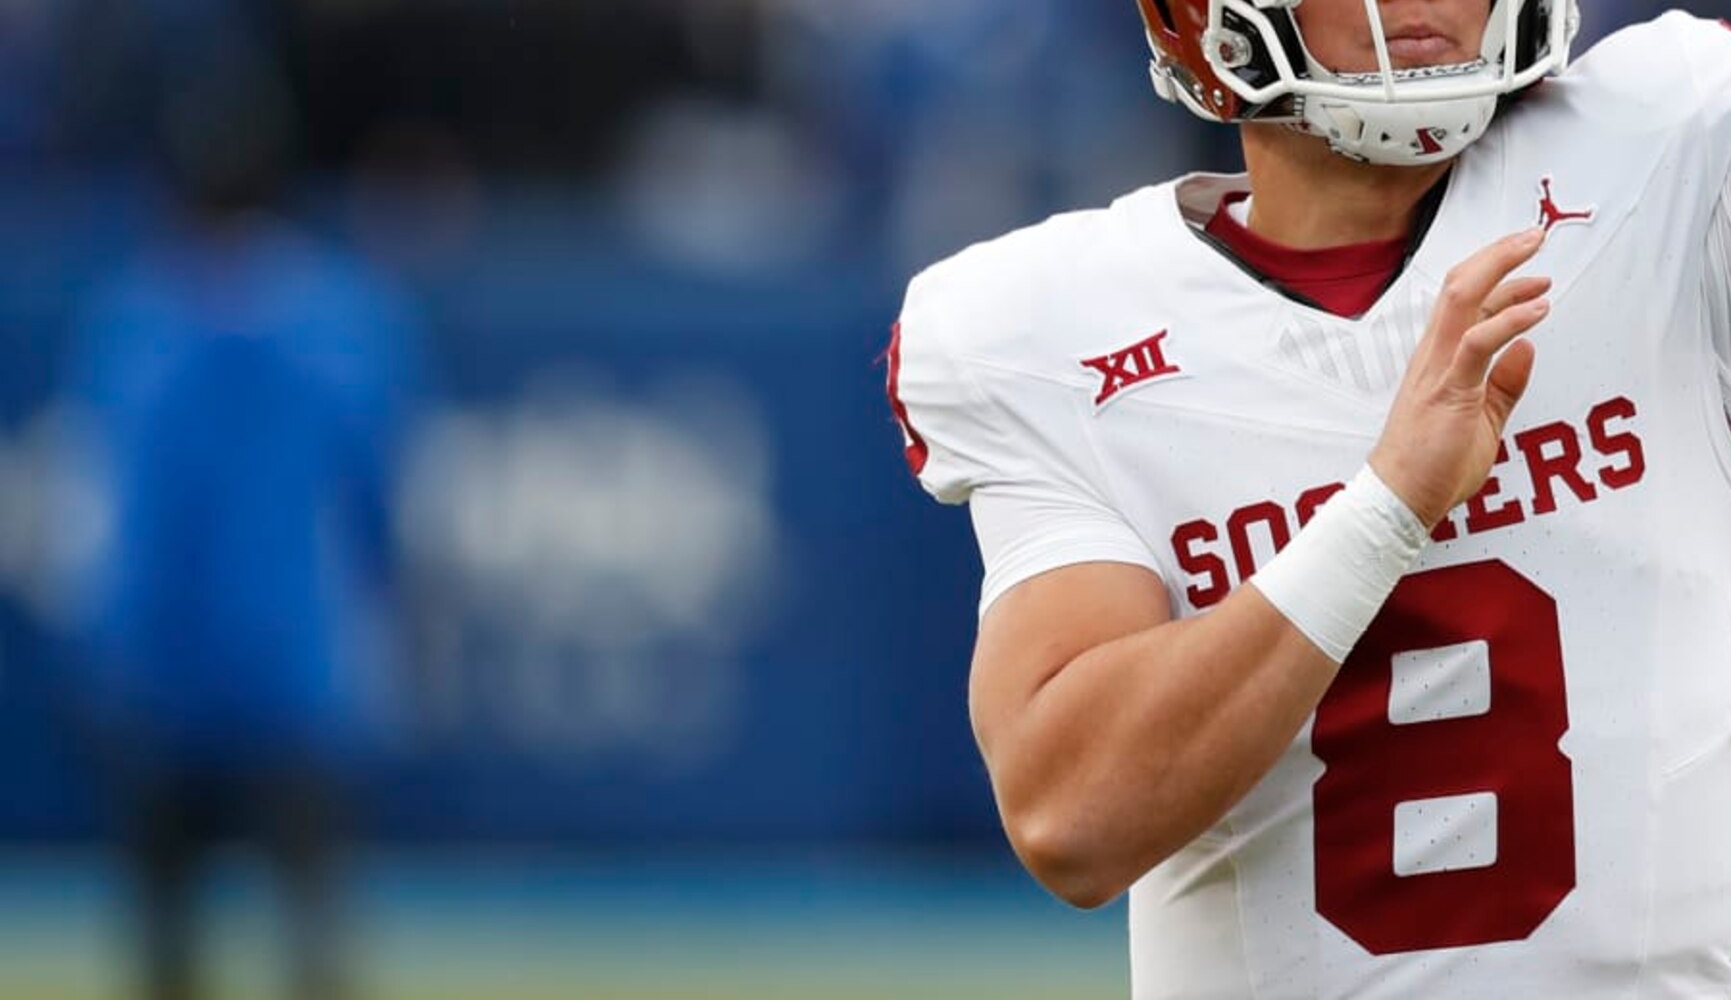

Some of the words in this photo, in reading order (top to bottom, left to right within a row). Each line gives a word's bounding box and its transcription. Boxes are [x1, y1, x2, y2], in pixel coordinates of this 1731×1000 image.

[1080, 329, 1180, 406] XII
[1171, 396, 1645, 609] SOERS
[1310, 557, 1576, 956] 8
